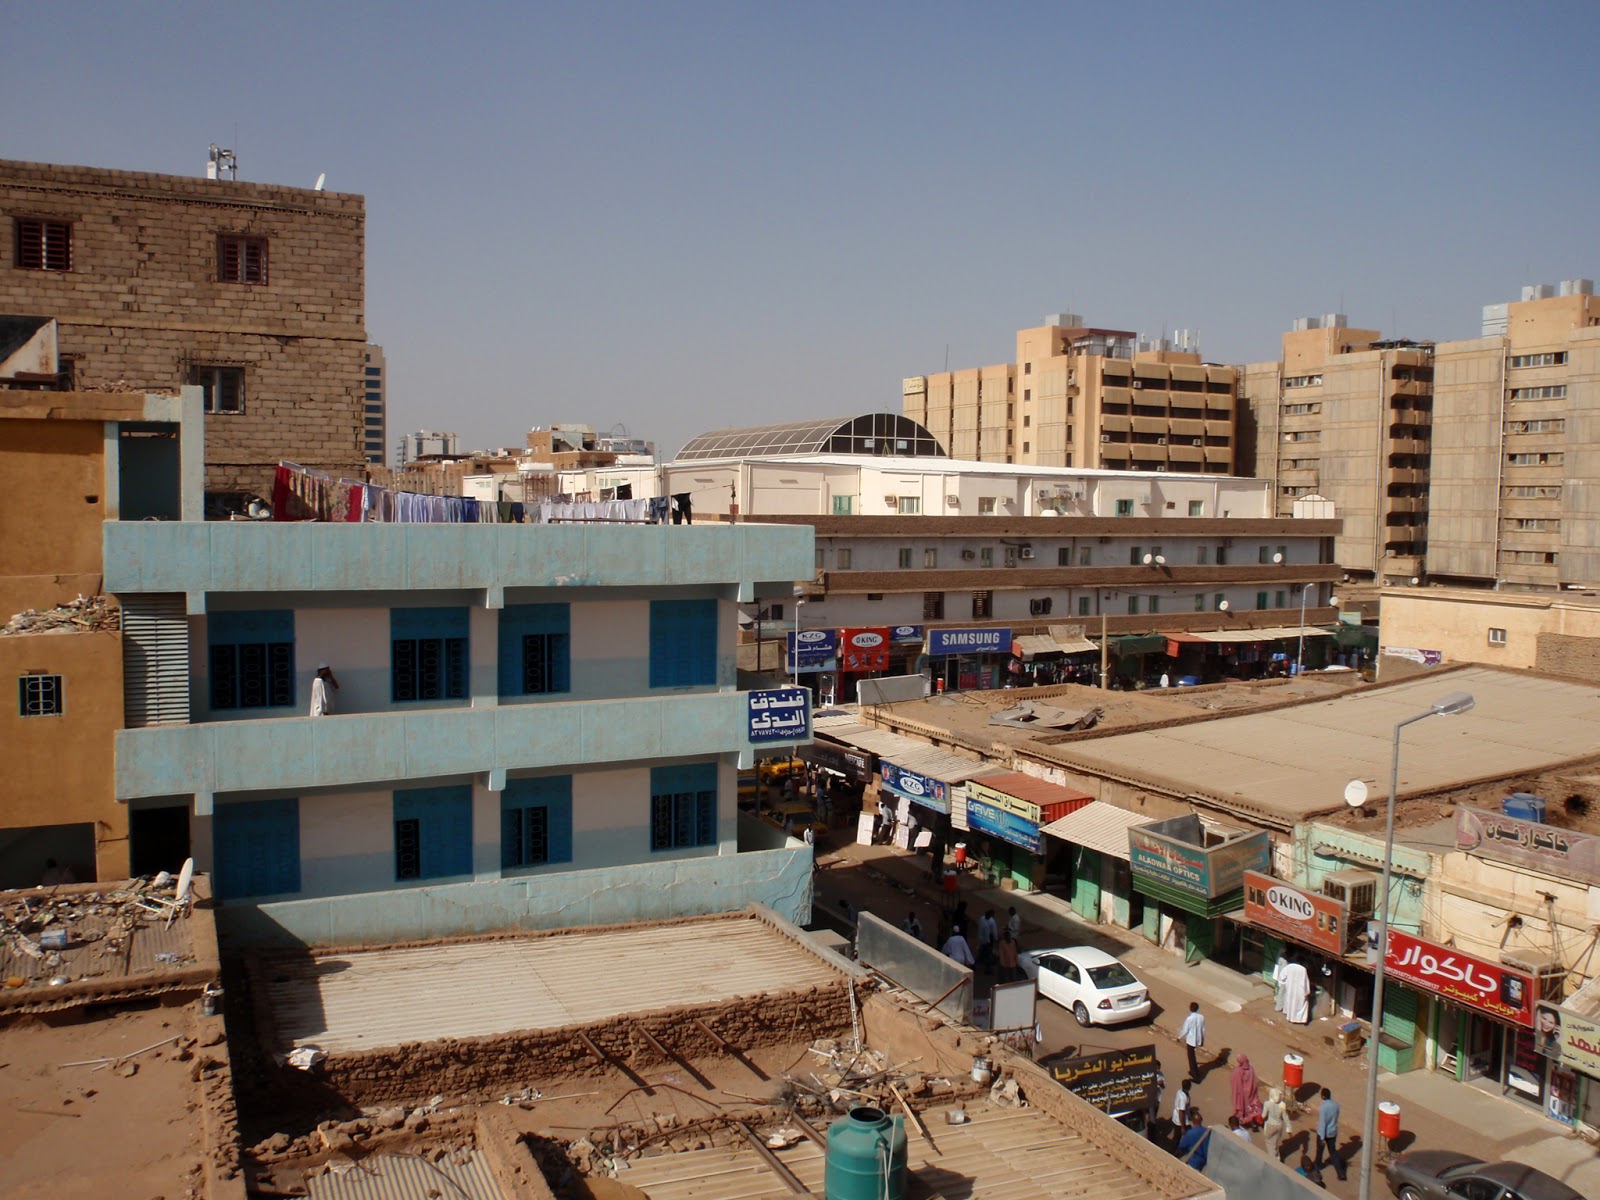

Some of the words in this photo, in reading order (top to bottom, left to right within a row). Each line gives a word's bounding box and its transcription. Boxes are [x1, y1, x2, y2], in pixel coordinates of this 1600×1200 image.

[942, 632, 1000, 646] SAMSUNG
[750, 690, 805, 710] فندق
[903, 778, 920, 791] KZG
[1486, 823, 1519, 841] فون
[1520, 828, 1569, 856] جاكوار
[1173, 866, 1200, 882] OPTICS
[1399, 945, 1498, 998] جاكوار
